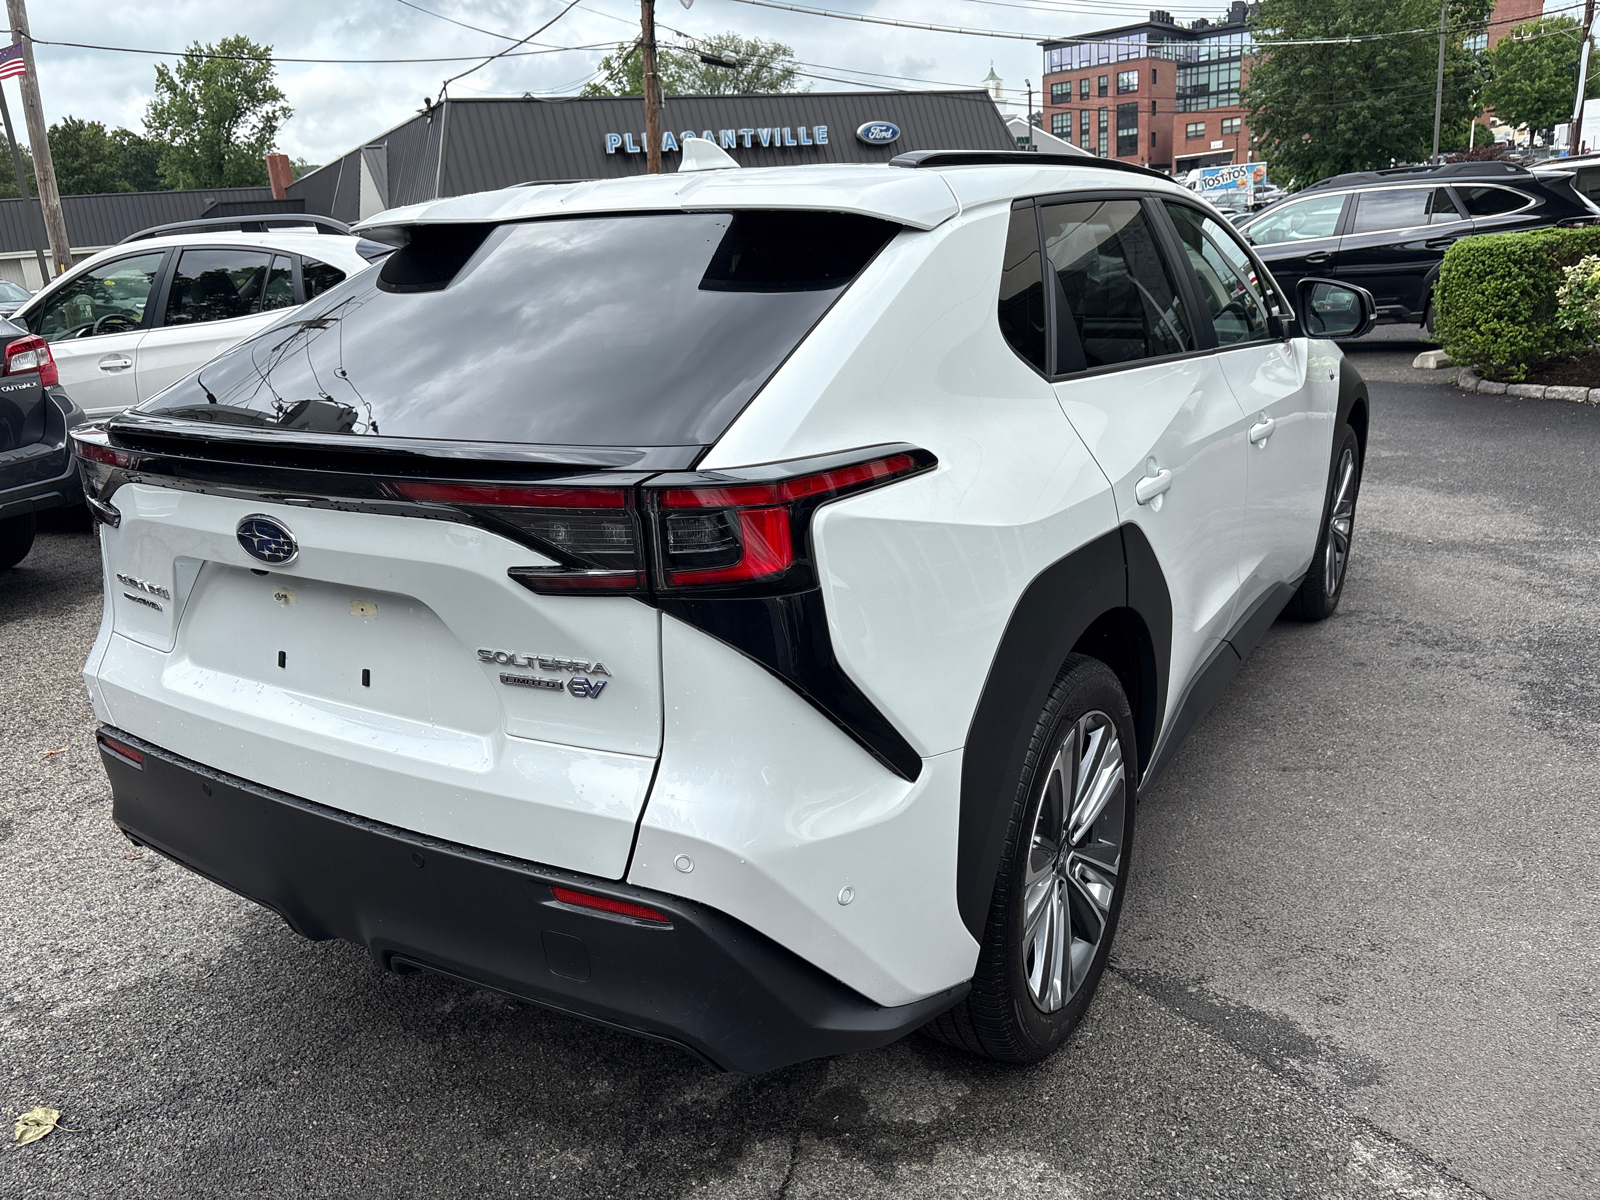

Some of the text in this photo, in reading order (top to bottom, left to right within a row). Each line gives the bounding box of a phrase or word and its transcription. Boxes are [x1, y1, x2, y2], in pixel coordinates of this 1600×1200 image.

[605, 125, 828, 154] PLAANTVILLE
[868, 125, 893, 139] Ford
[1, 381, 38, 392] OUTBACK
[477, 648, 612, 676] SOLTERRA
[505, 676, 607, 699] LIMITED EV
